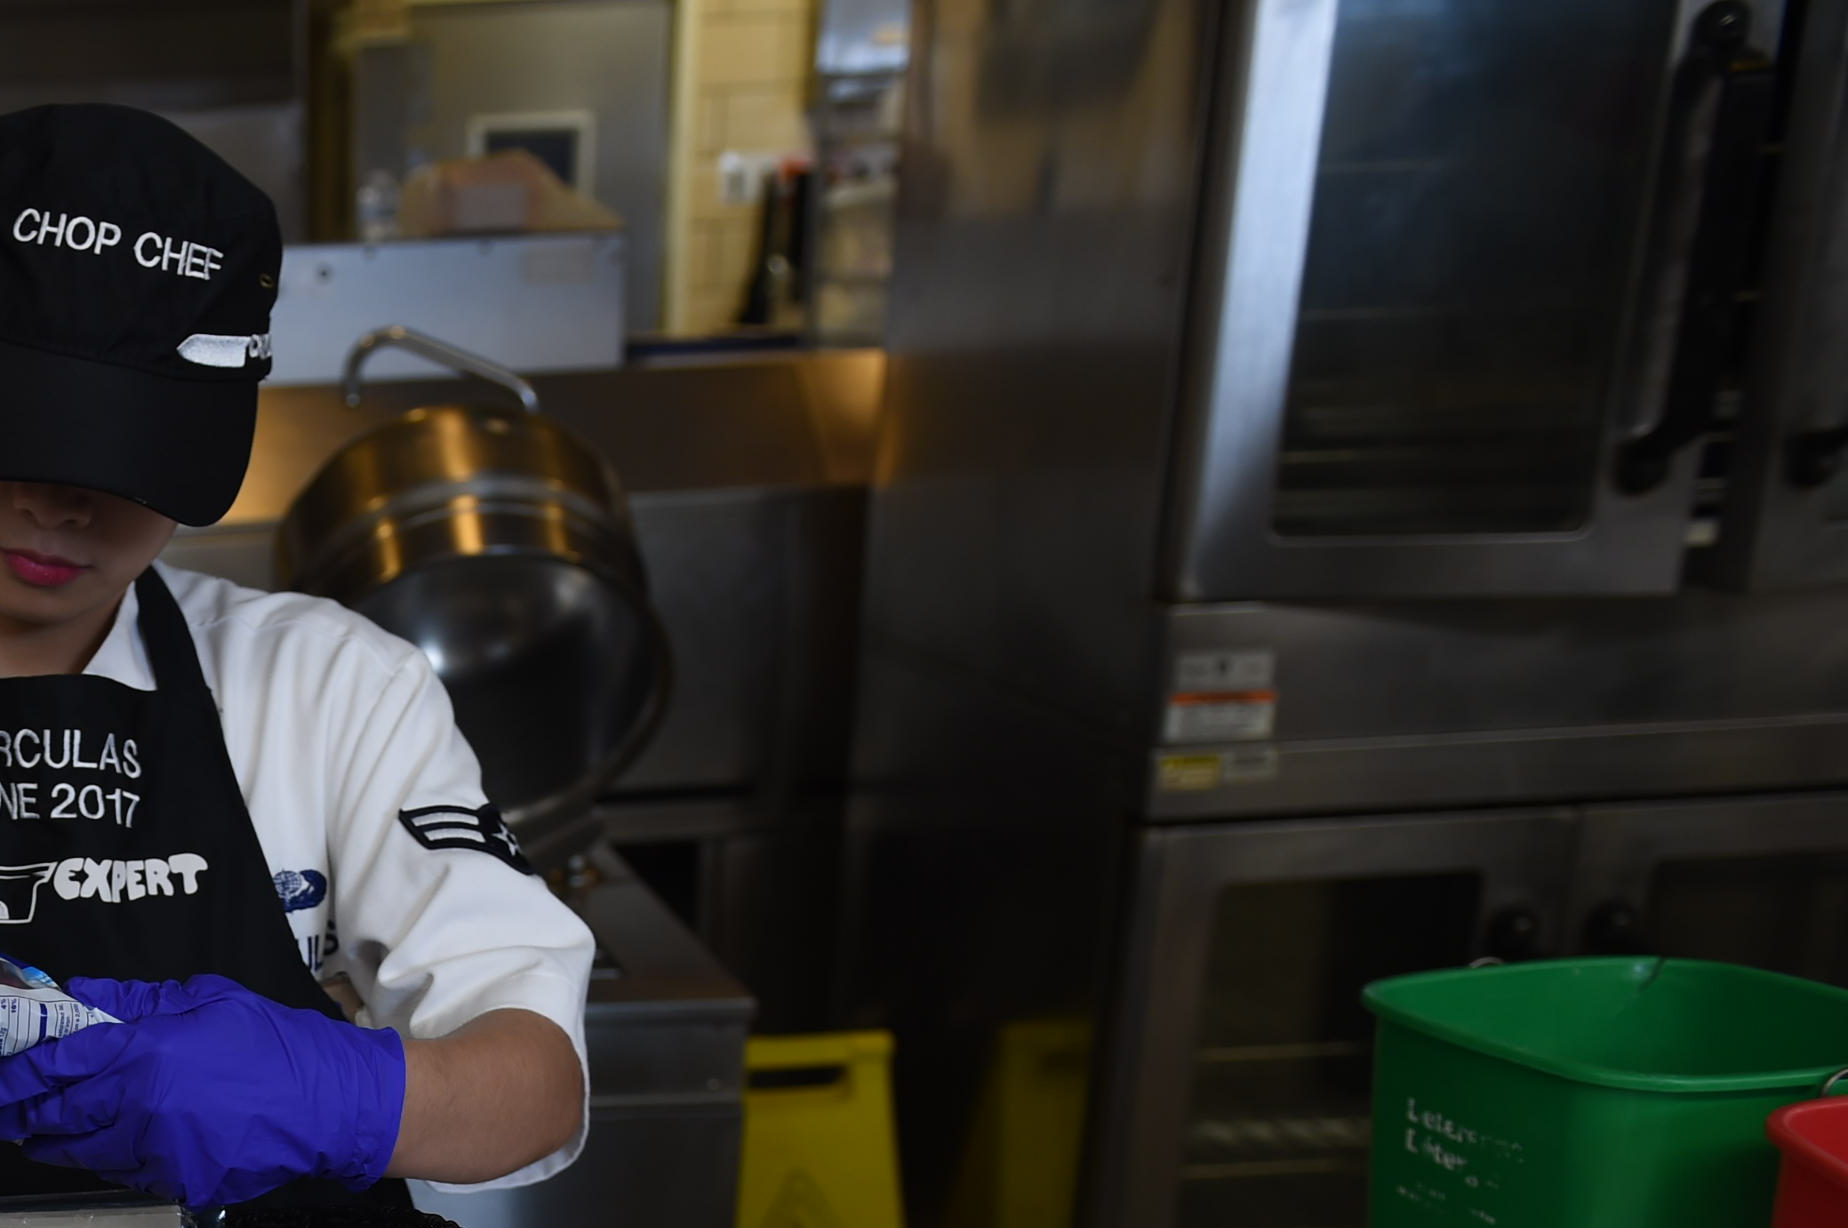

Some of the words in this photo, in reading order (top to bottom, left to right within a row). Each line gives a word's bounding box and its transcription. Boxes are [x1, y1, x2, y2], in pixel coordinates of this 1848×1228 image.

[12, 207, 122, 255] CHOP
[132, 231, 225, 281] CHEF
[50, 782, 141, 829] 2017
[53, 853, 208, 903] EXPERT
